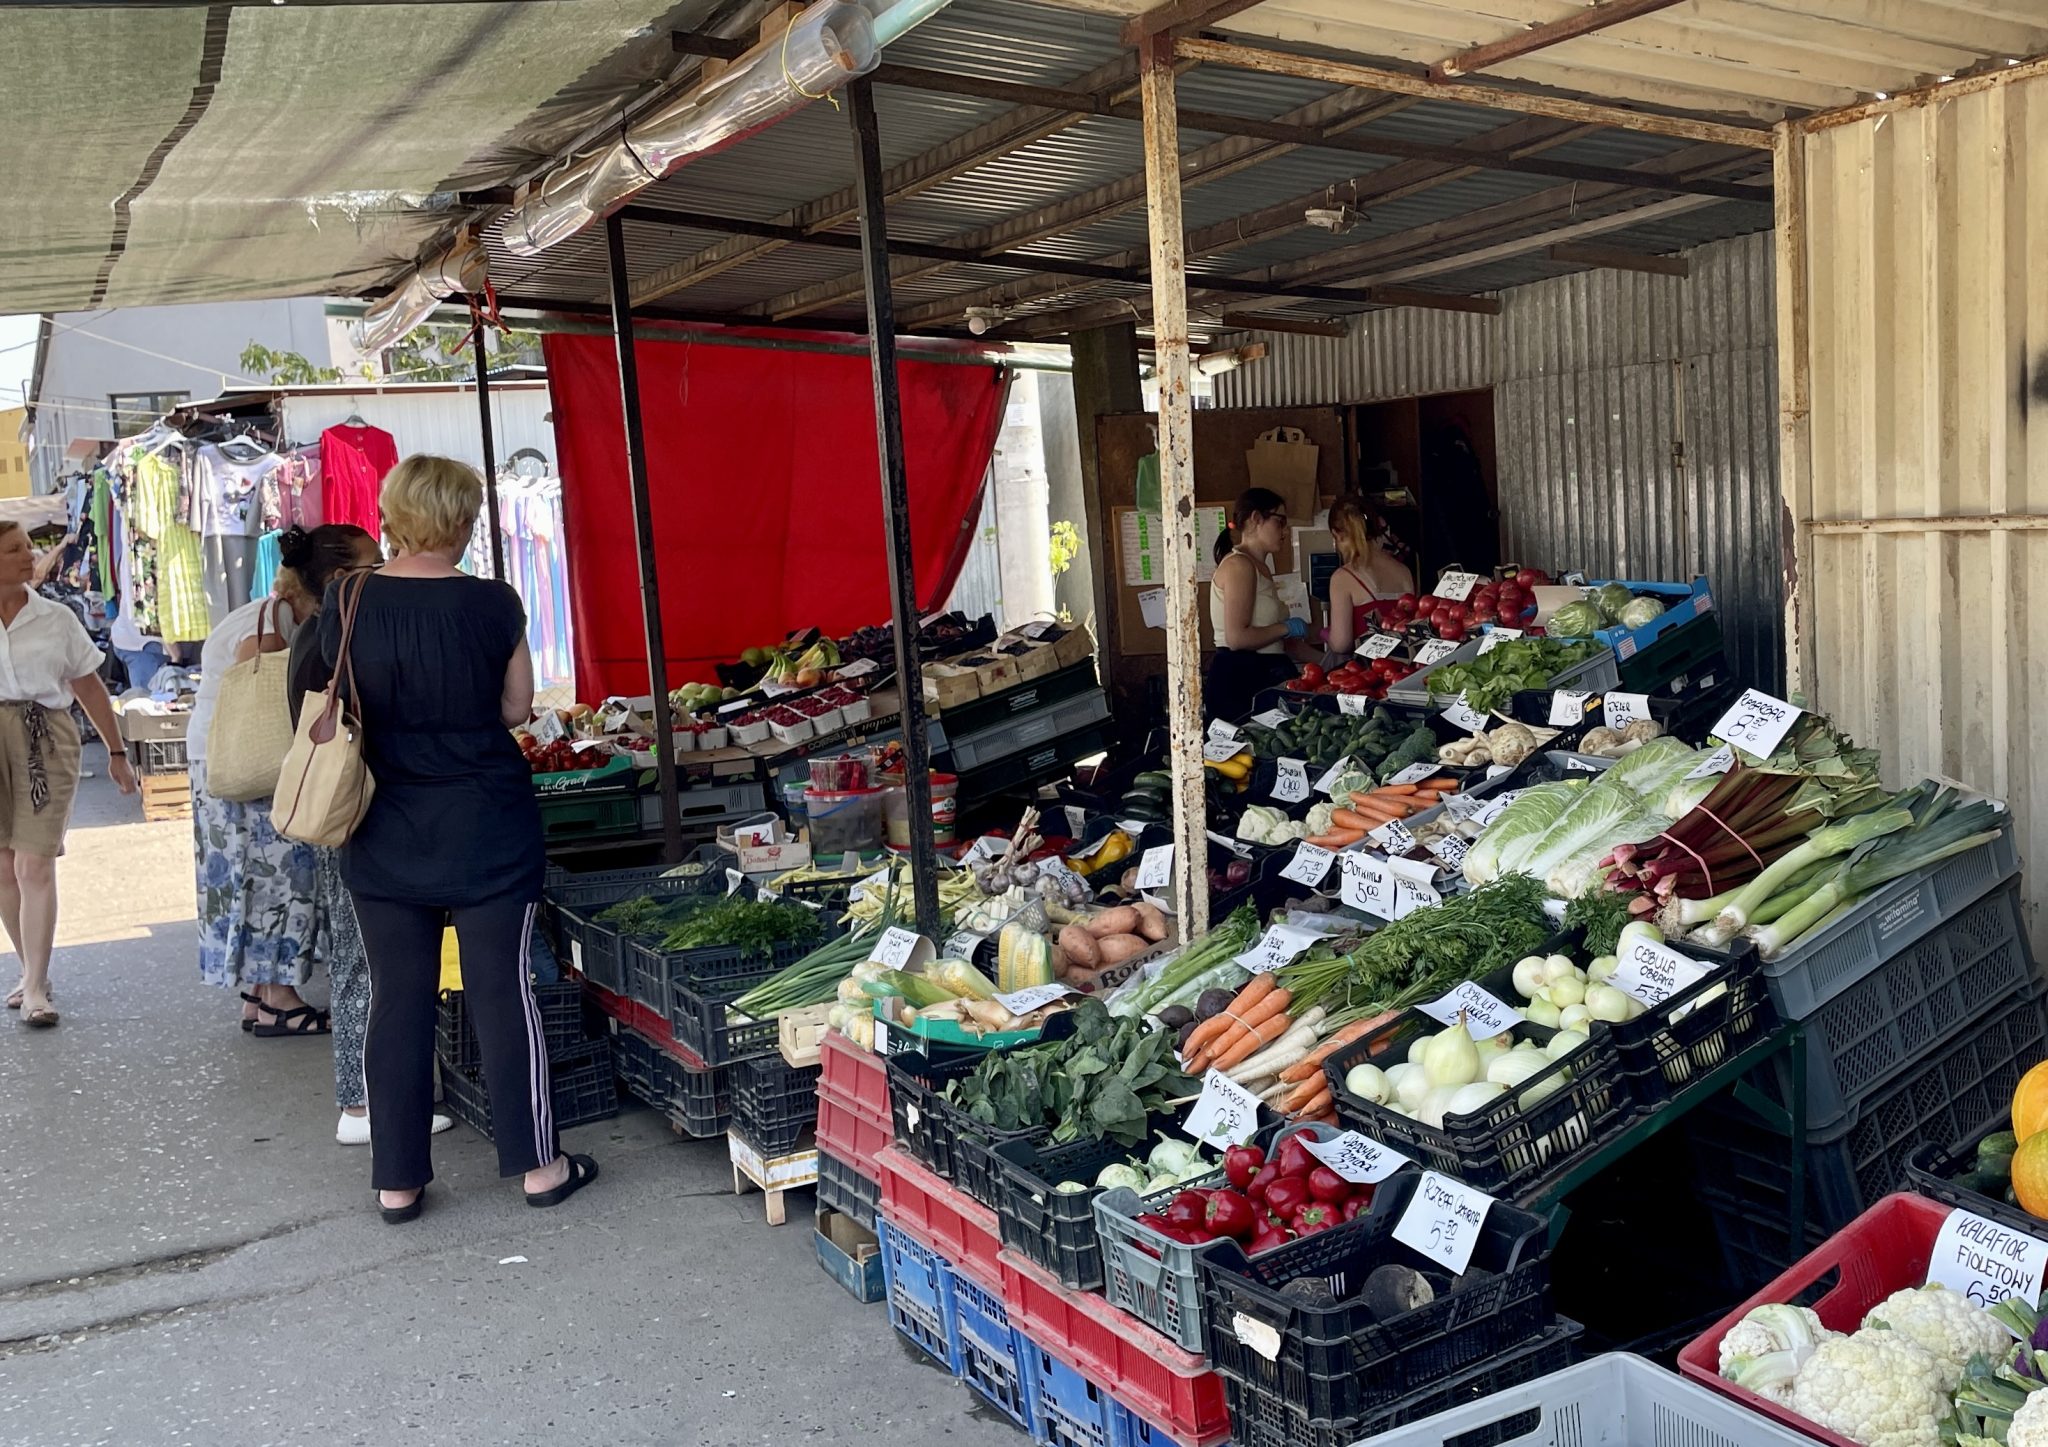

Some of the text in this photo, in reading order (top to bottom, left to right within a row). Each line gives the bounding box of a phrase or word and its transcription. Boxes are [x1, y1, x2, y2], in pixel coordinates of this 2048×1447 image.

[1634, 945, 1677, 975] CEBULA
[1456, 983, 1498, 1013] CEBULA
[1956, 1217, 2029, 1263] KALAFIOR
